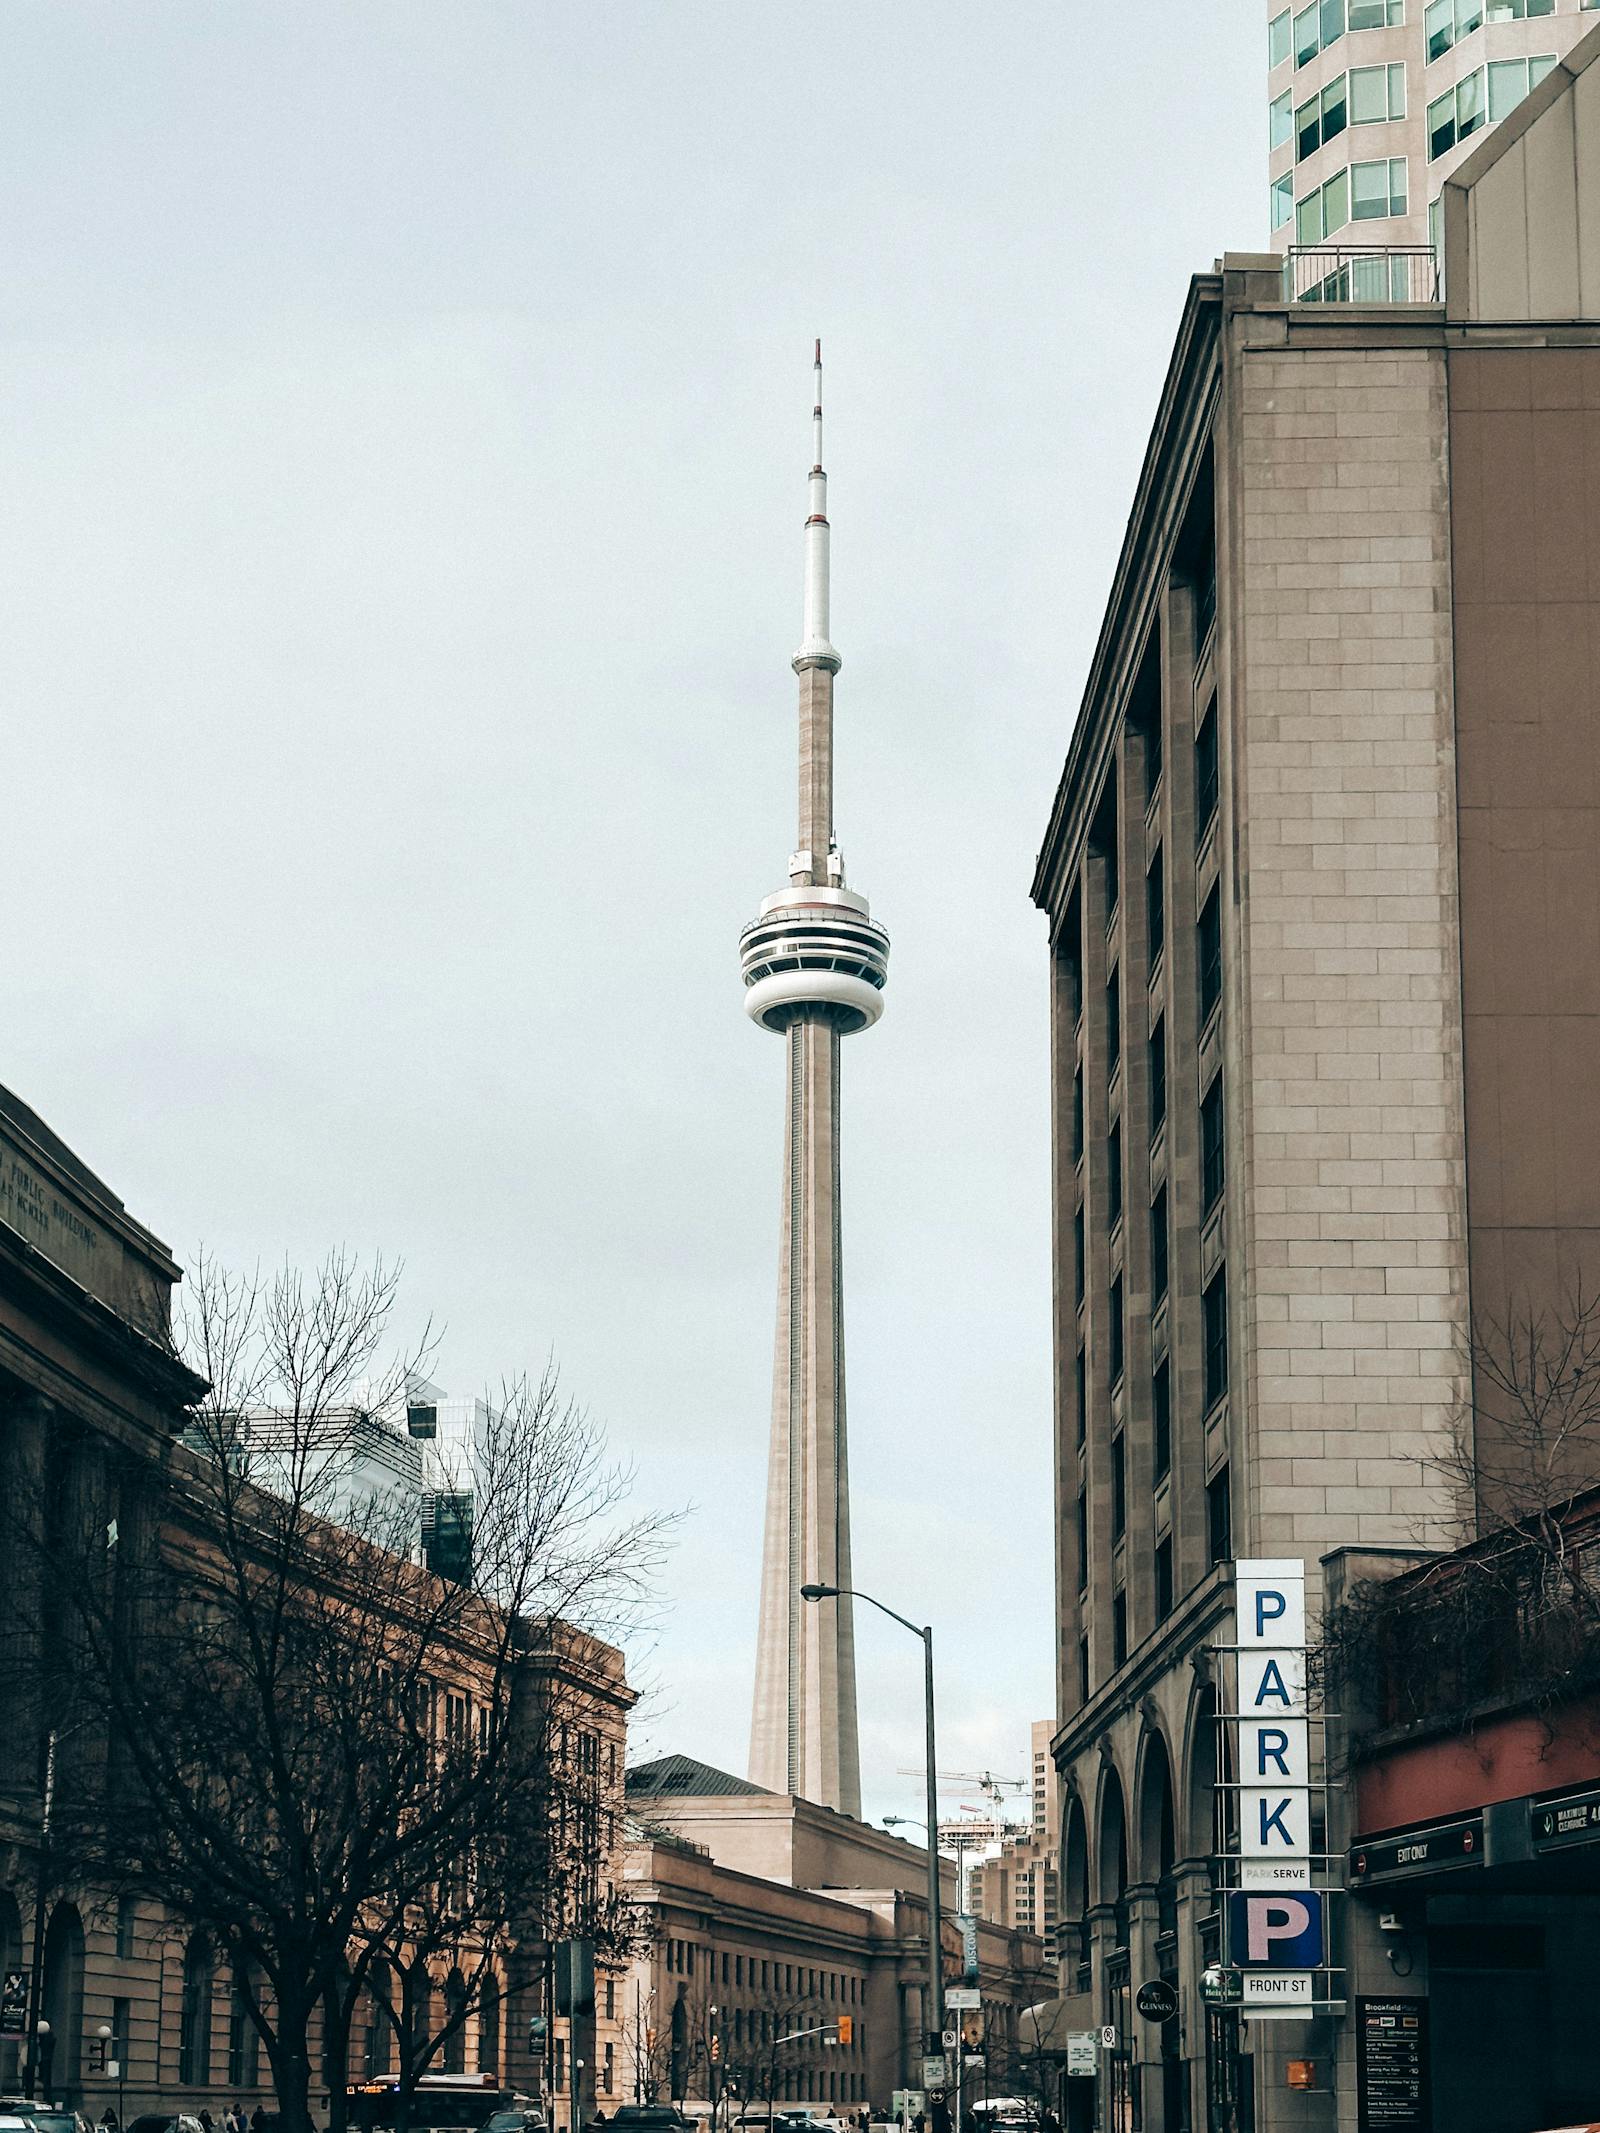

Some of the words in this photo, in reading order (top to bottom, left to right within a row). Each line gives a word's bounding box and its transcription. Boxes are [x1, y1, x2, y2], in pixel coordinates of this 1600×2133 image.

[1254, 1590, 1294, 1846] PARK
[1558, 1806, 1588, 1821] MAXIMUM
[1558, 1817, 1589, 1833] CLEARANCE
[1397, 1848, 1411, 1863] EXIT
[1411, 1844, 1428, 1861] ONLY
[1247, 1897, 1310, 1961] P
[967, 1918, 978, 1966] DISCOVER
[1250, 1980, 1288, 1992] FRONT
[1291, 1980, 1307, 1992] ST
